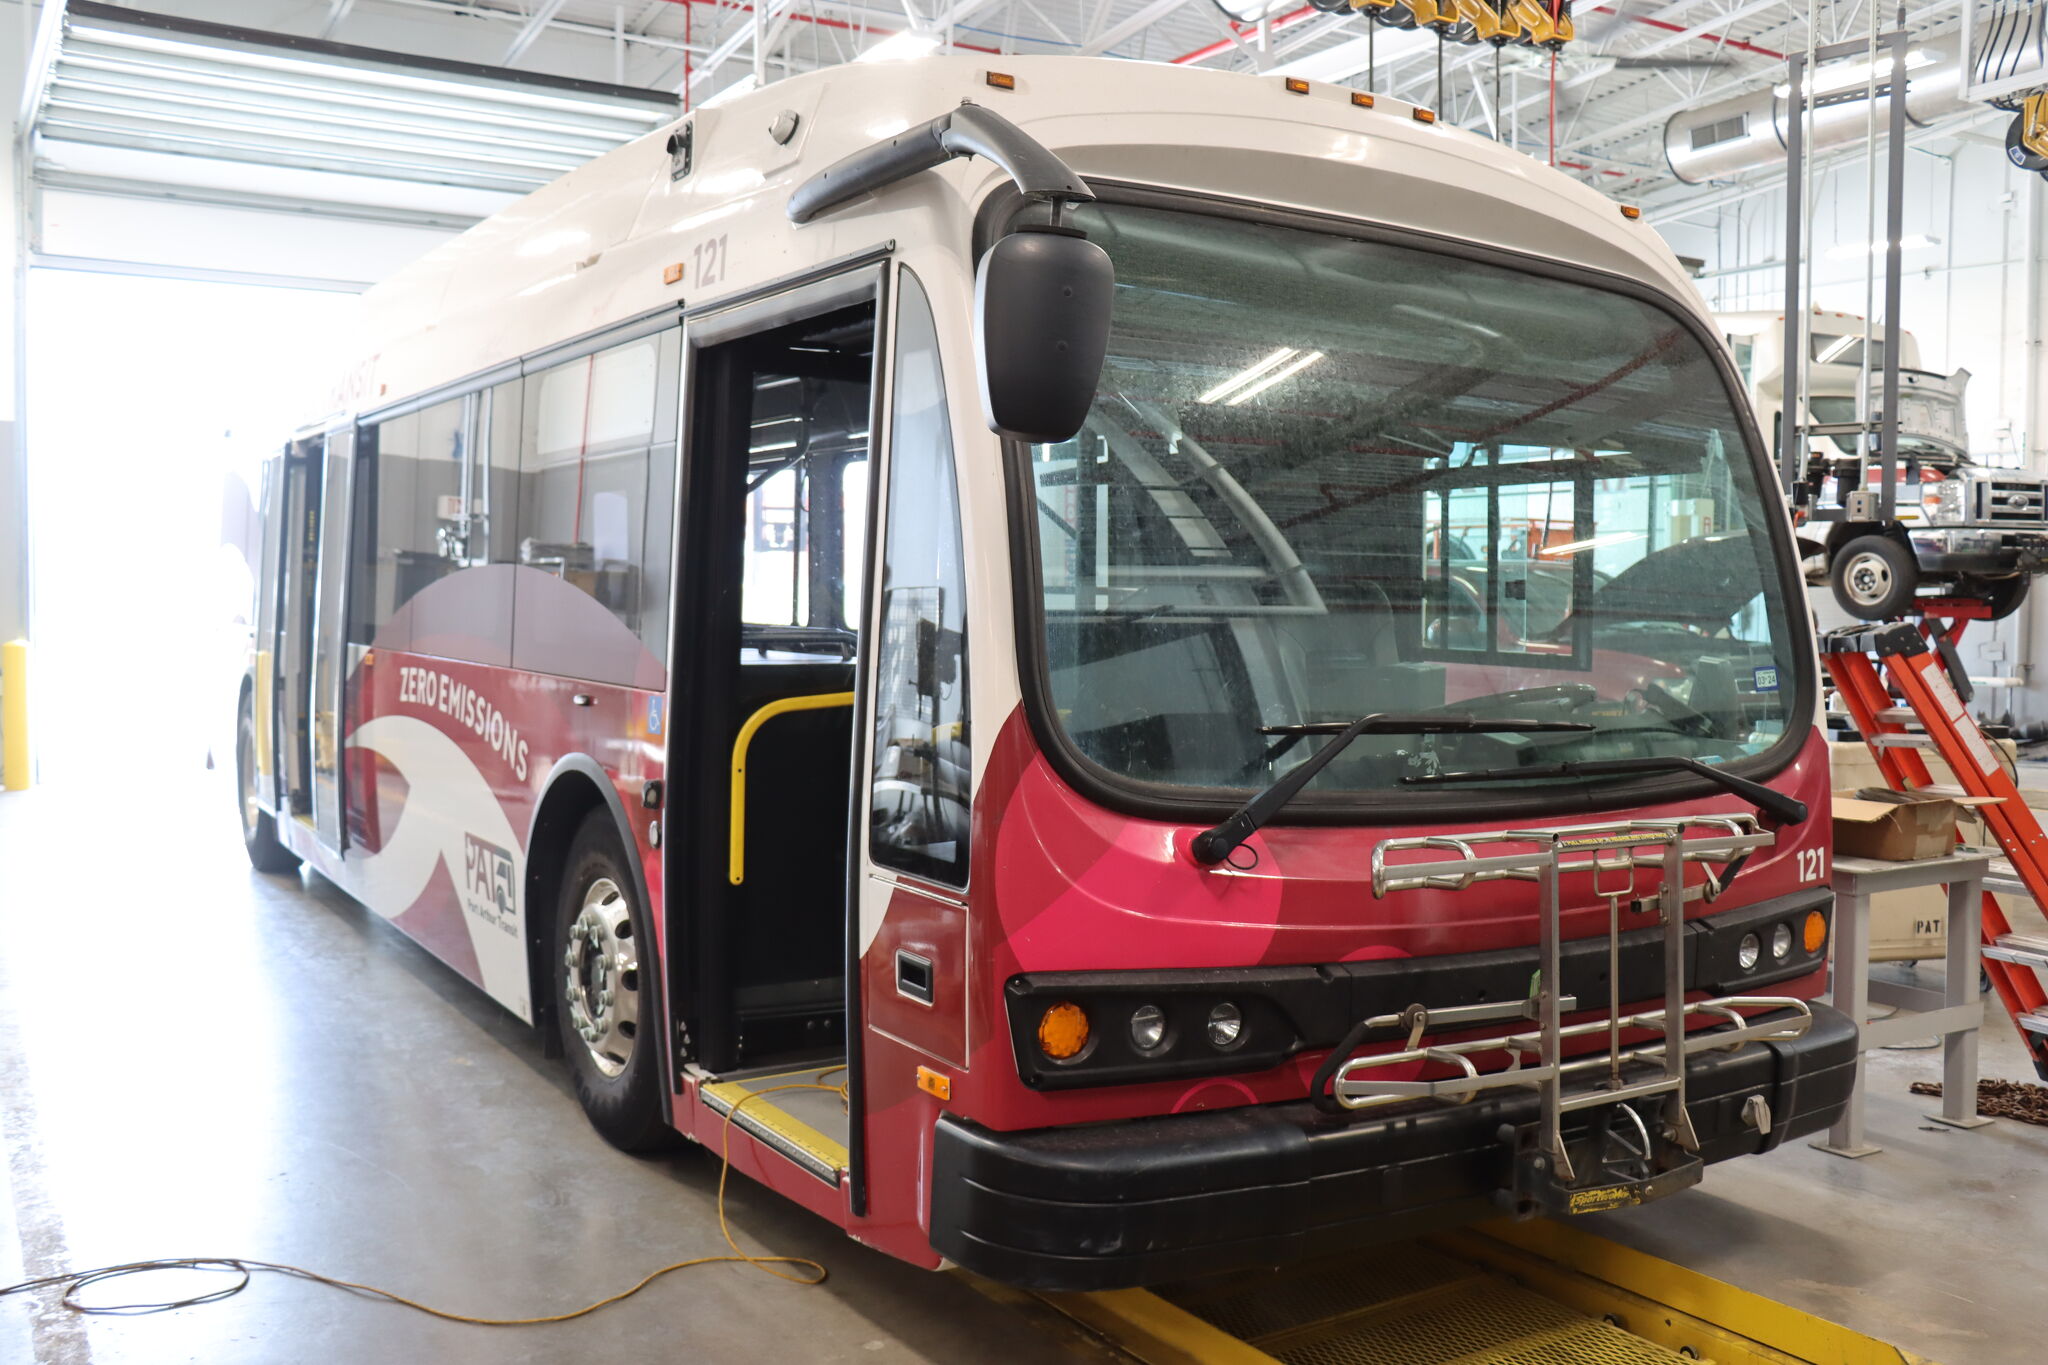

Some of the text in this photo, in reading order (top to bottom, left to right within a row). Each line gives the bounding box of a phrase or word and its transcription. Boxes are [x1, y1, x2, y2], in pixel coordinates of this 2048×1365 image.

[693, 233, 728, 290] 121
[400, 667, 529, 782] ZERO EMISSIONS
[1796, 846, 1825, 883] 121
[1916, 919, 1940, 934] PAT
